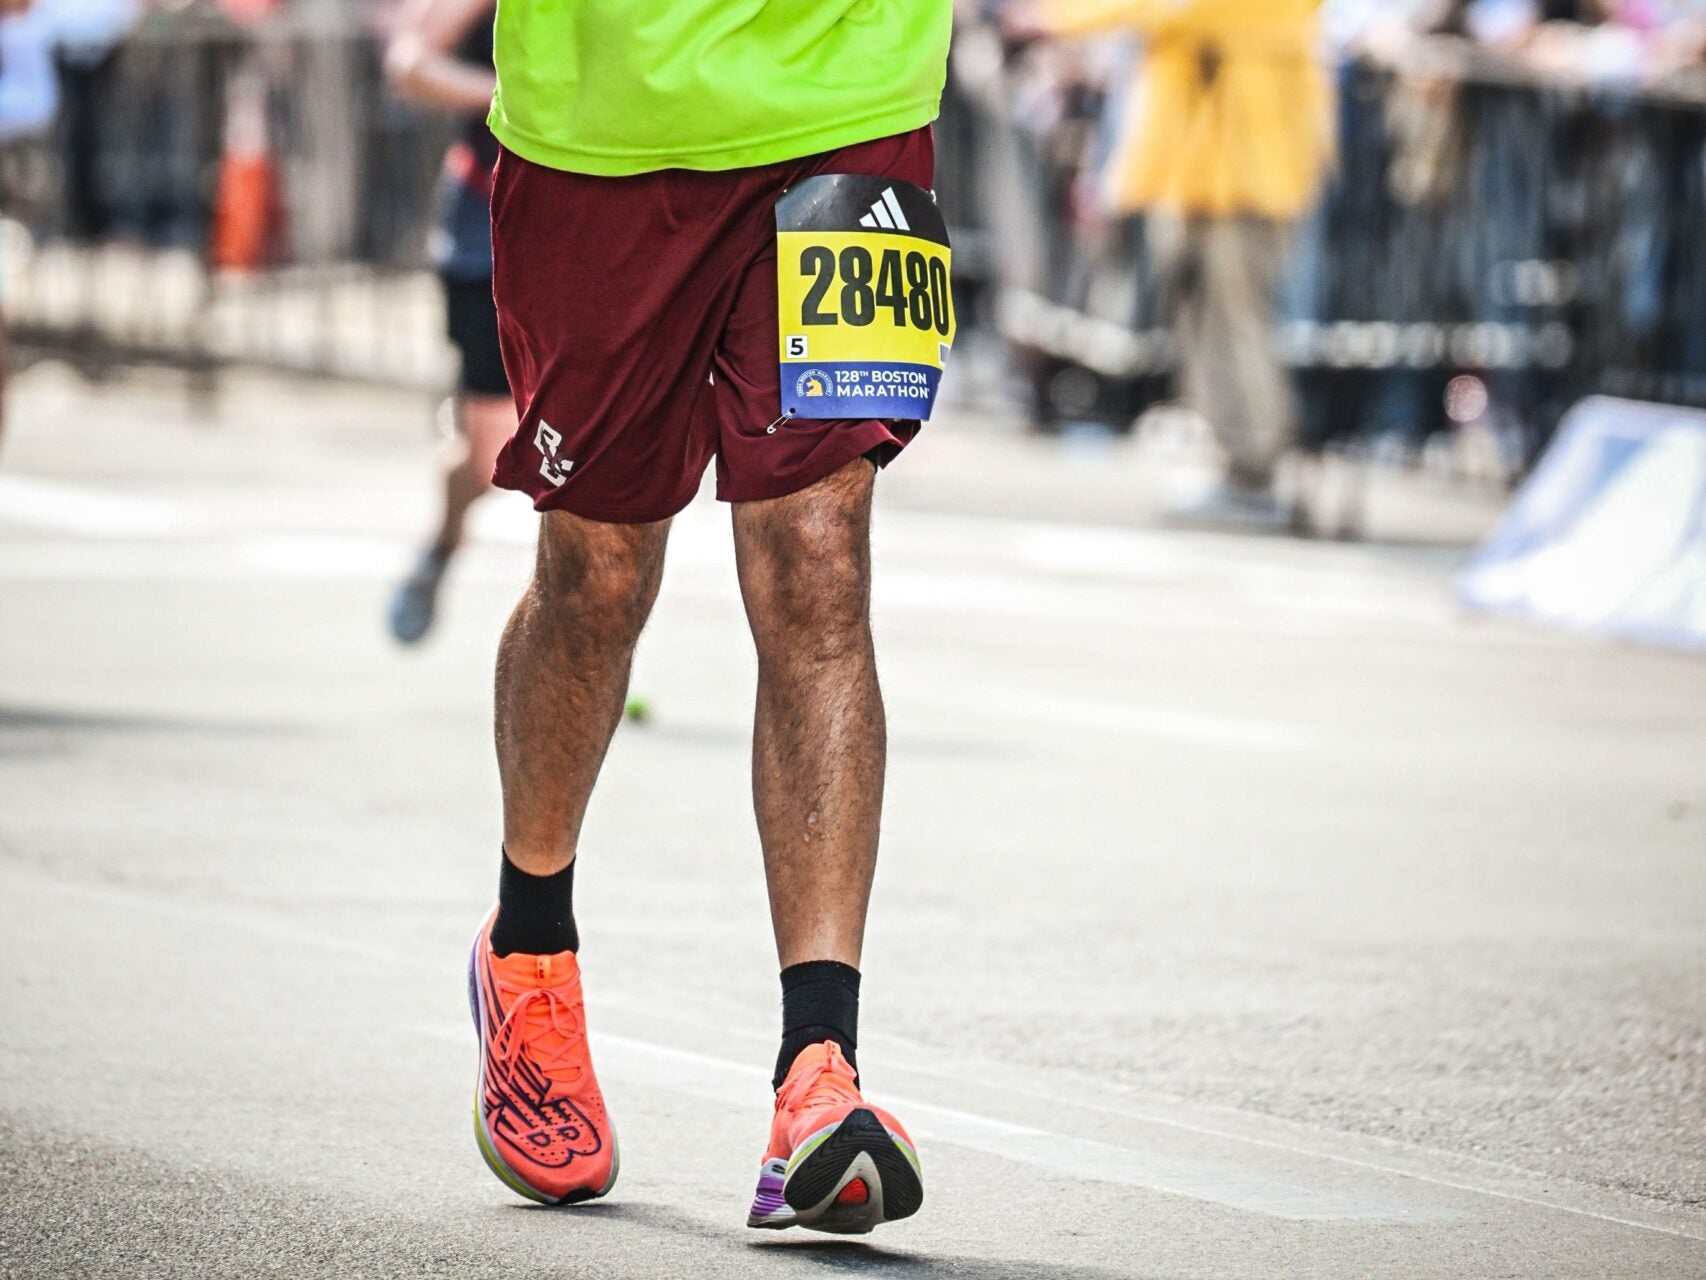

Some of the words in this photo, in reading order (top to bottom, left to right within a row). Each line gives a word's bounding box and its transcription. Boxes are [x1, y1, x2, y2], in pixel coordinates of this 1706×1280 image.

[800, 245, 950, 336] 28480
[790, 338, 804, 356] 5
[835, 370, 868, 383] 128TH
[872, 370, 927, 385] BOSTON
[836, 384, 929, 399] MARATHON
